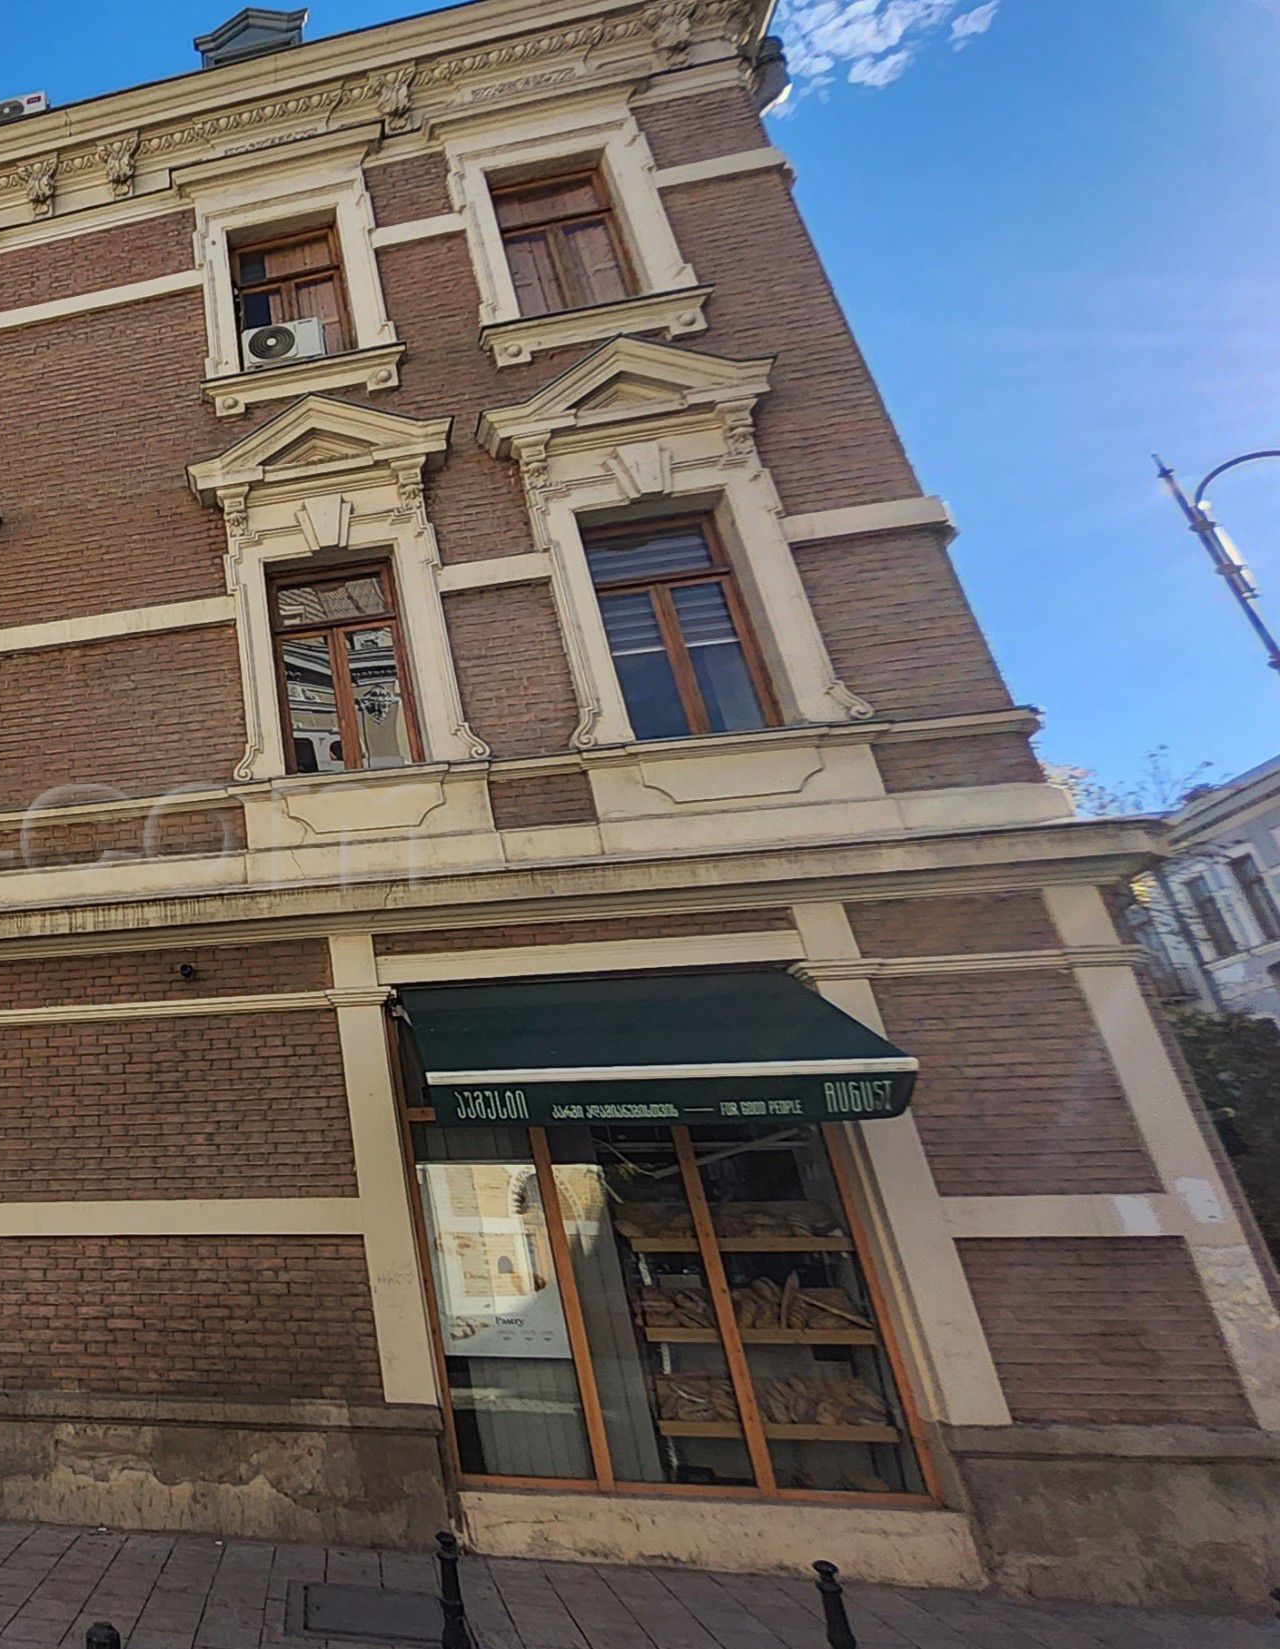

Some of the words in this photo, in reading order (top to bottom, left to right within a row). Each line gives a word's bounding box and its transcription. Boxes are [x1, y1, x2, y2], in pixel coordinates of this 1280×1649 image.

[720, 1101, 741, 1117] FOR
[740, 1101, 767, 1116] GOOD
[768, 1099, 804, 1115] PEOPLE
[824, 1080, 893, 1113] AUGUST
